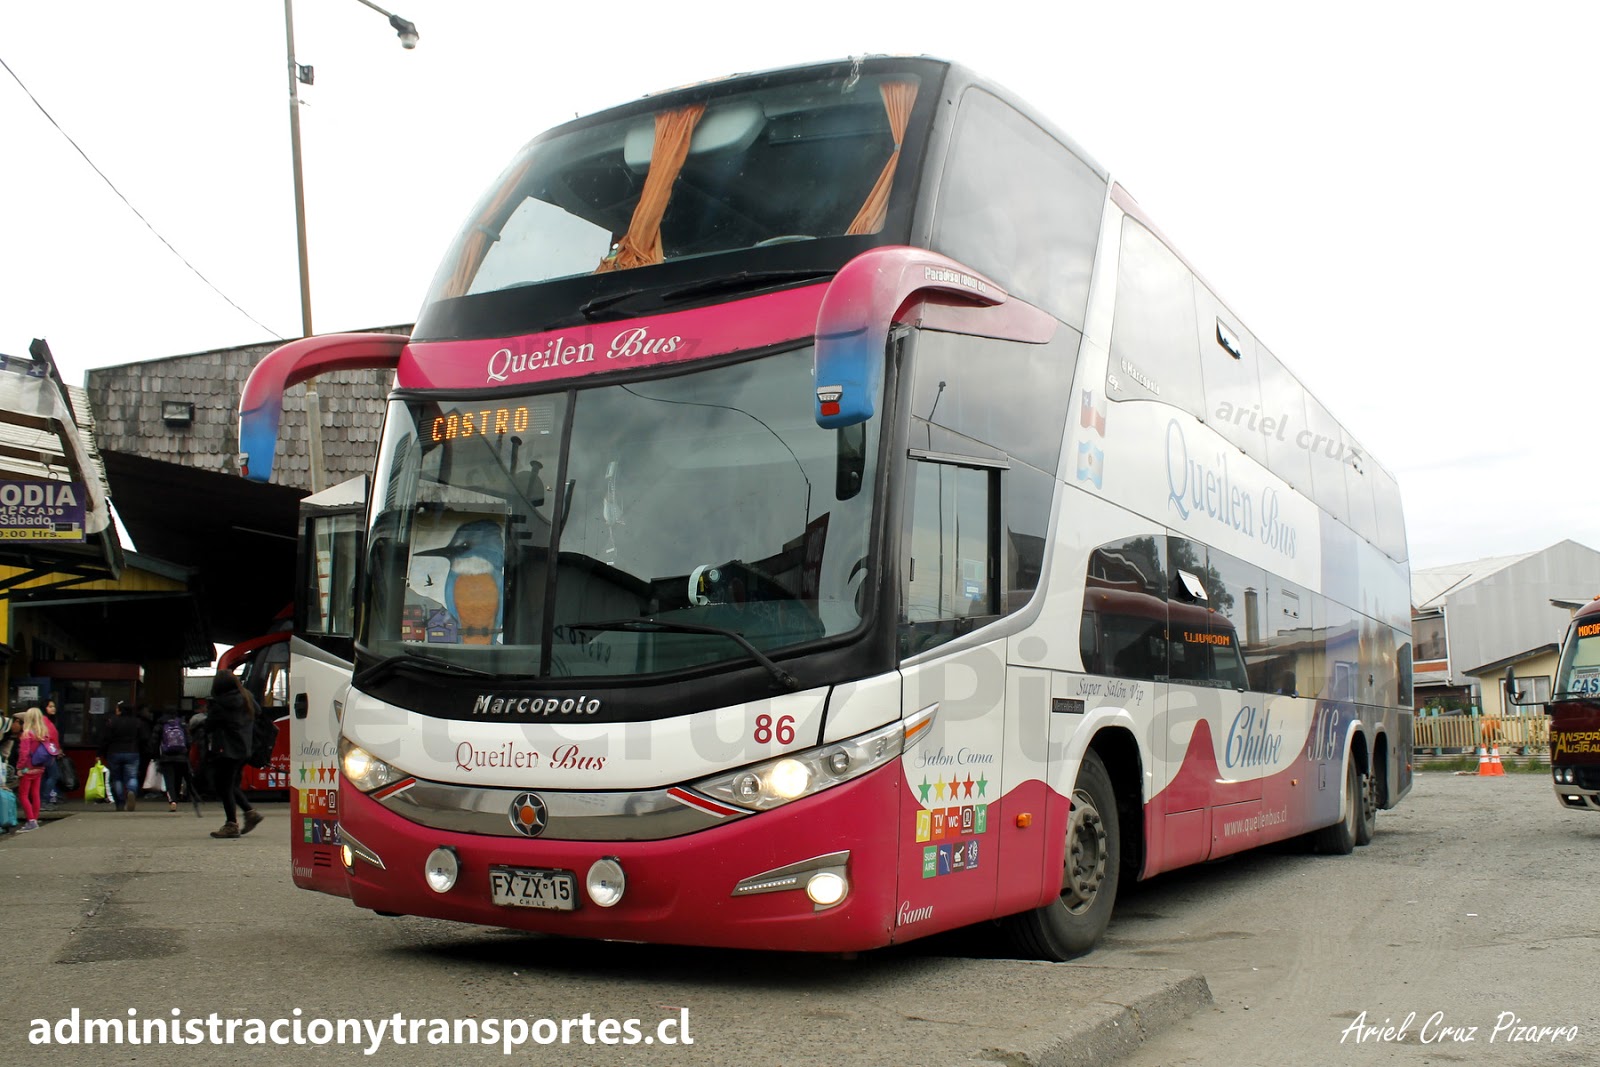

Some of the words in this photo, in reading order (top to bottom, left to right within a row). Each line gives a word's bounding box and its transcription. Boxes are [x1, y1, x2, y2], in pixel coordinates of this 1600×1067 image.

[487, 337, 594, 383] Queilen
[606, 326, 686, 359] Bus
[431, 407, 529, 441] CASTRO
[1166, 418, 1254, 538] Queilen
[1260, 486, 1296, 559] Bus
[1076, 678, 1102, 701] Super
[473, 694, 600, 716] Marcopolo
[753, 713, 796, 745] 86
[1225, 705, 1284, 768] Chiloé
[456, 741, 540, 772] Queilen
[549, 744, 609, 771] Bus
[957, 747, 994, 766] Cama
[934, 813, 944, 827] TV
[948, 815, 959, 828] WC
[519, 899, 546, 907] CHILE
